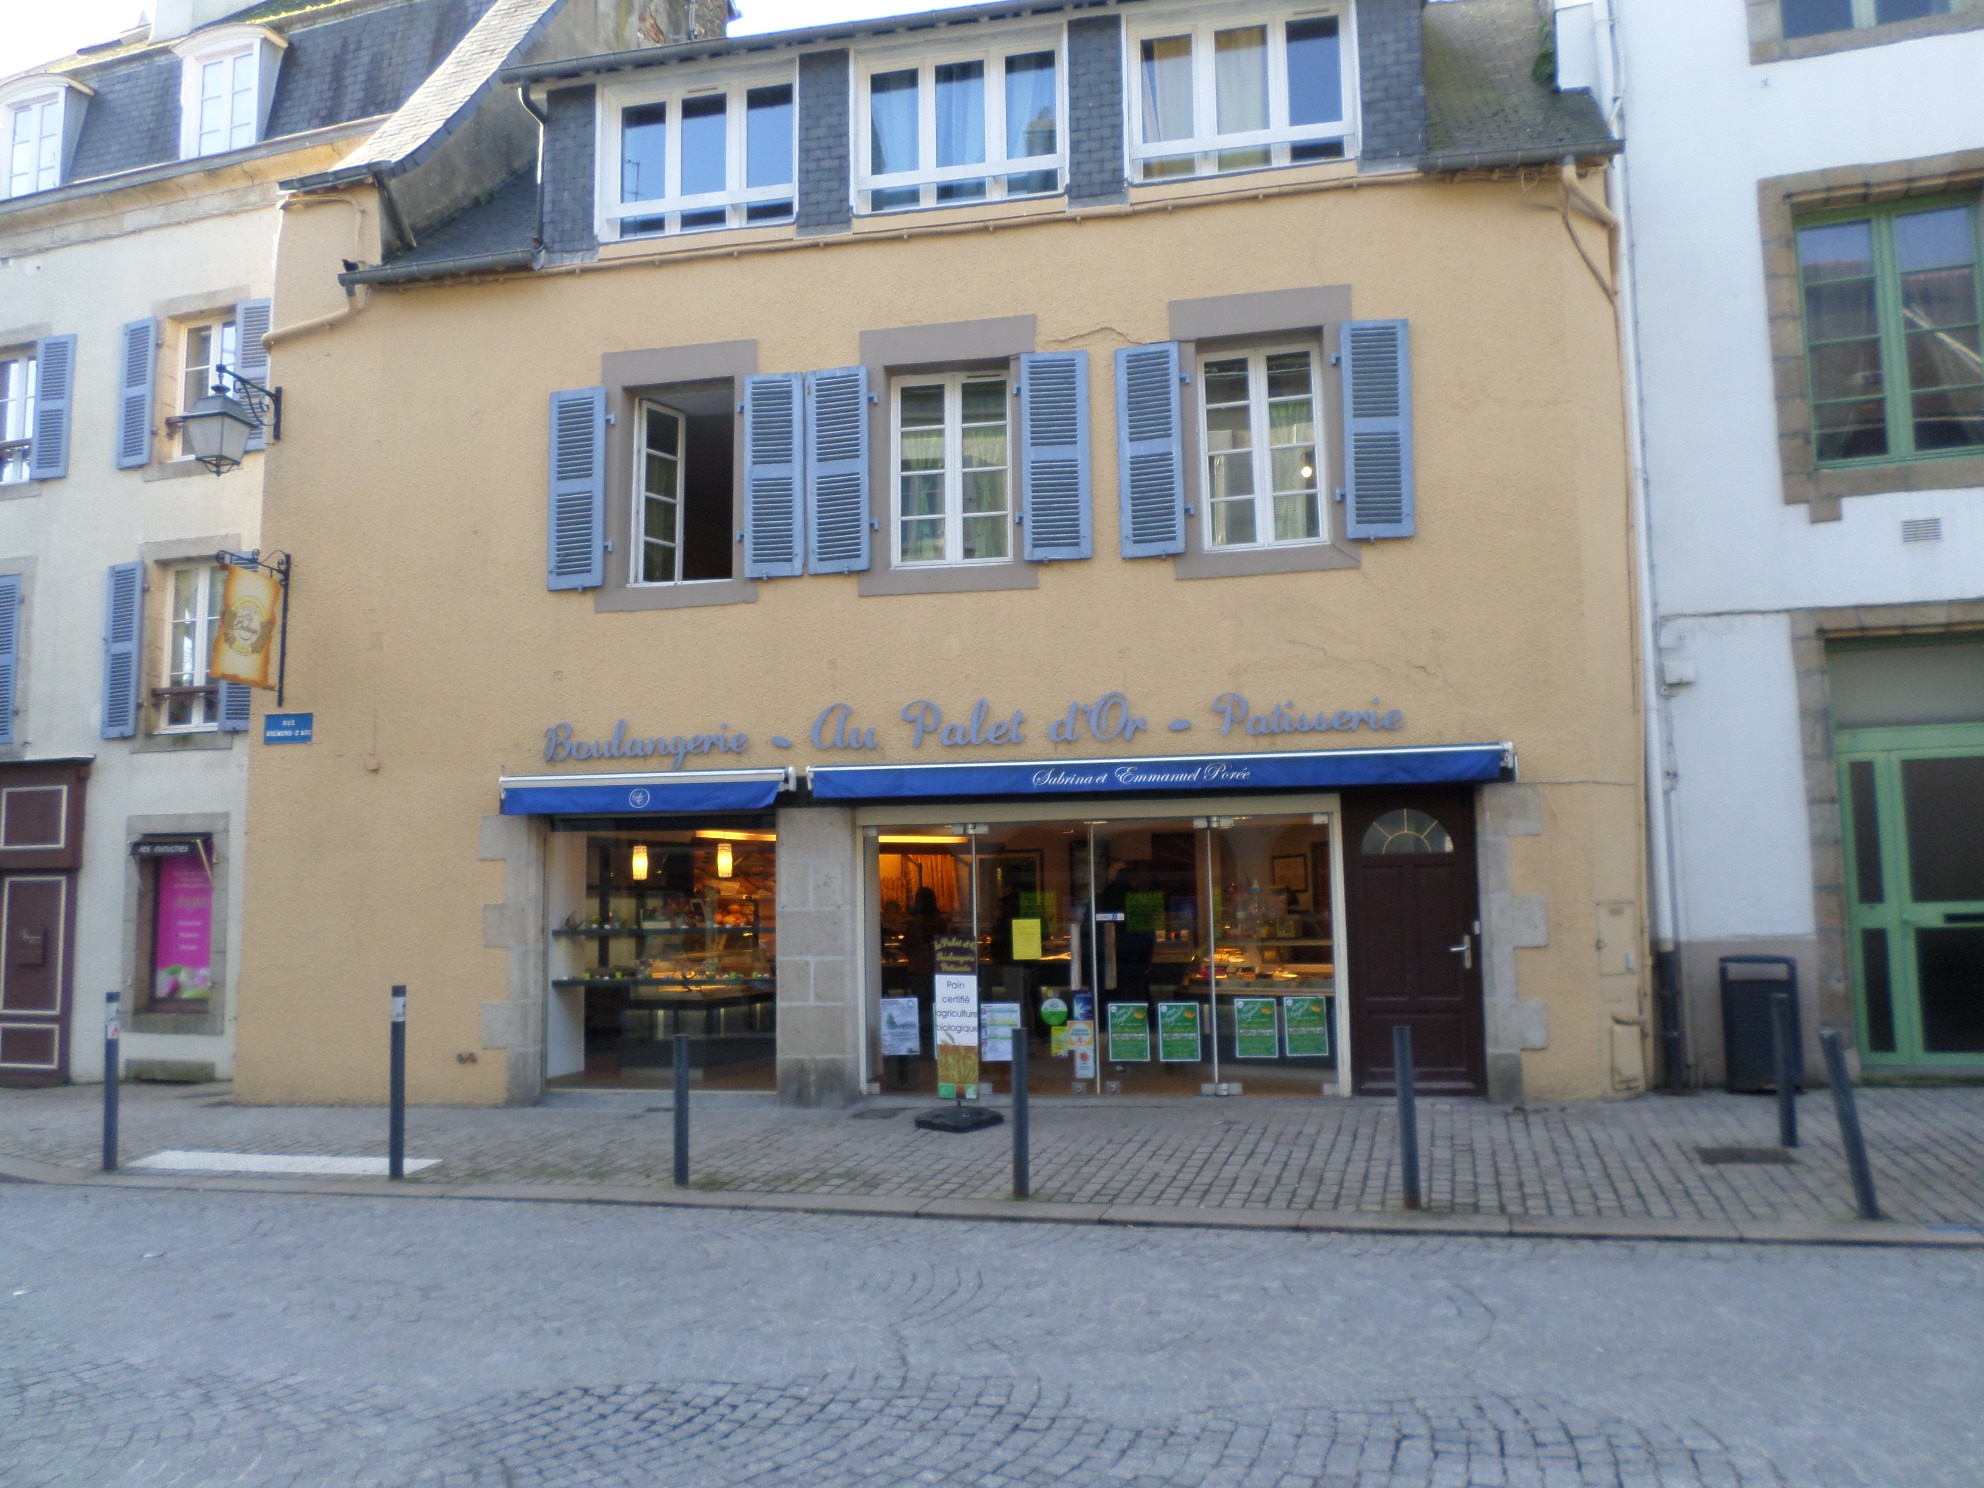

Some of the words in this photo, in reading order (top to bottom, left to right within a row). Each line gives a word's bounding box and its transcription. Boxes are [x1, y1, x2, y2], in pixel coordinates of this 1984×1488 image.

[543, 718, 748, 771] Boulangerie
[811, 702, 880, 750] Au
[901, 697, 1027, 749] Palet
[1048, 691, 1148, 743] d'Or
[1211, 692, 1406, 736] Patisserie
[1032, 767, 1094, 789] Sabrina
[1095, 773, 1108, 784] et
[1114, 761, 1202, 785] Emmanuel
[1203, 761, 1251, 781] Porée
[946, 981, 965, 989] Pain
[942, 995, 970, 1004] certifié
[936, 1009, 978, 1019] agriculture
